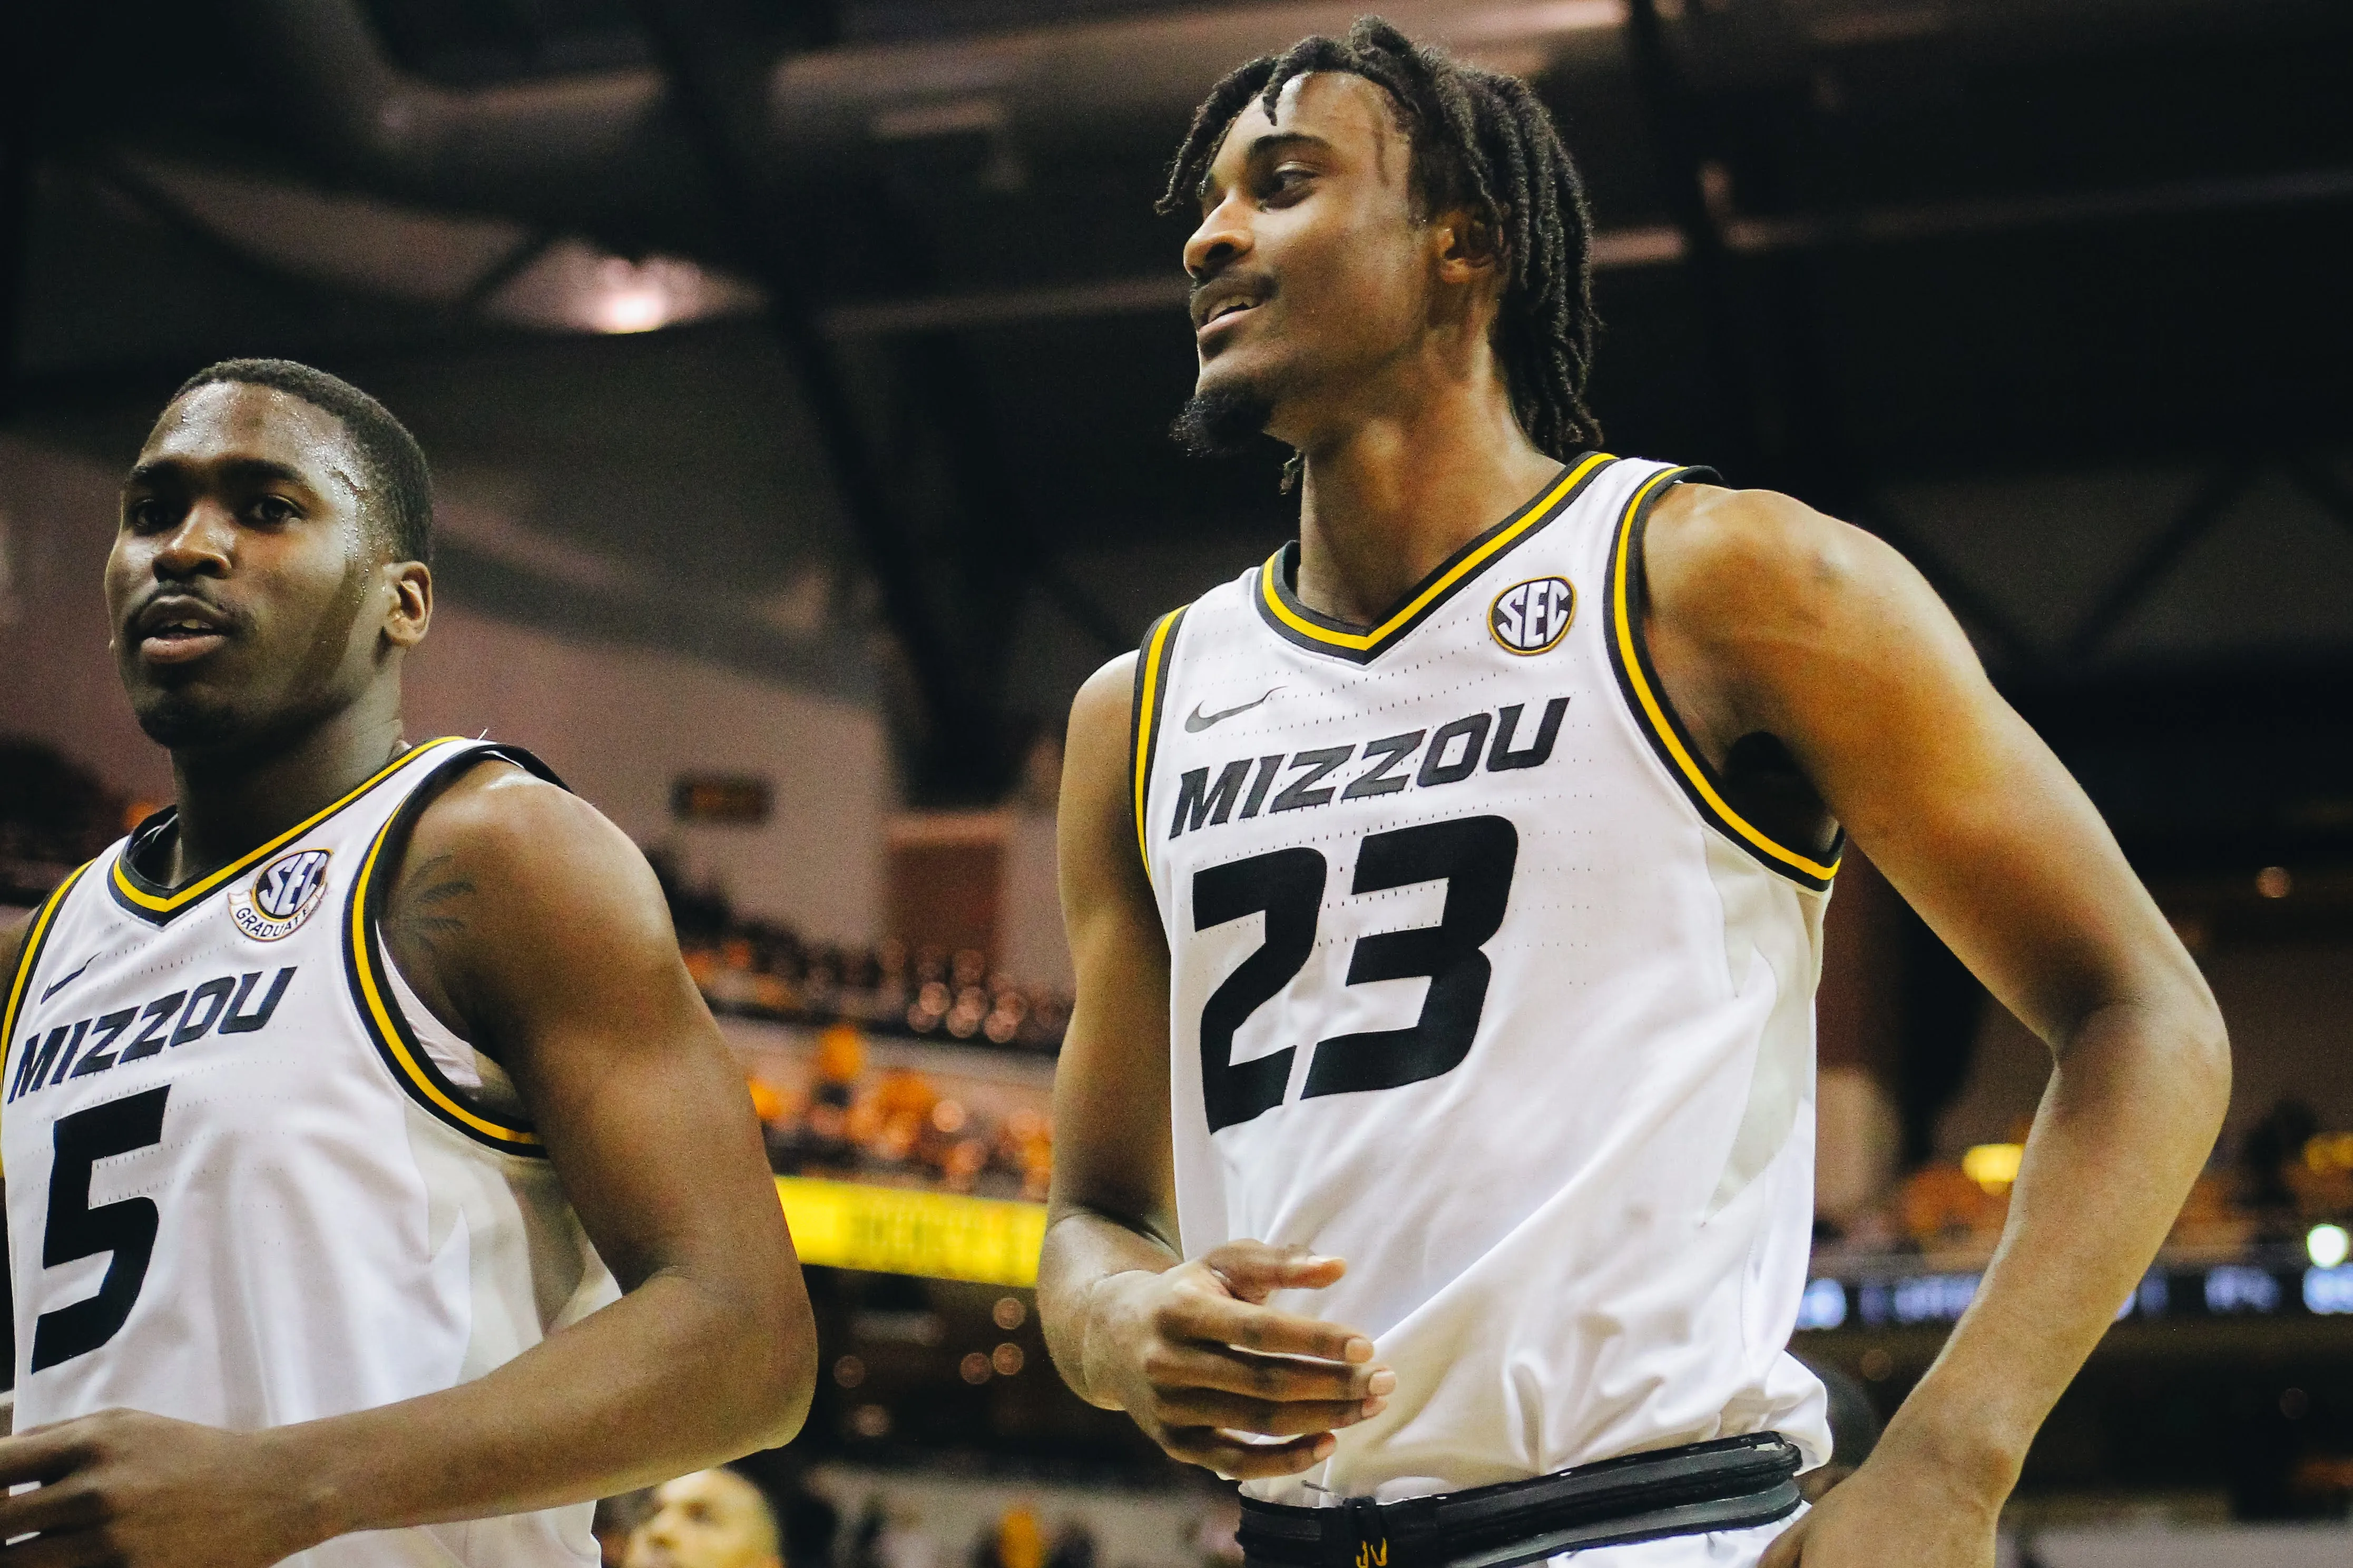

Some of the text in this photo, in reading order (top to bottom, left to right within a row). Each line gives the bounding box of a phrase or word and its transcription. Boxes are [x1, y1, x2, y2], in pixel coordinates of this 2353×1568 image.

[1497, 580, 1570, 647] SEC
[1169, 697, 1571, 840] MIZZOU
[258, 851, 328, 915] SEC
[8, 967, 298, 1104] MIZZOU
[1192, 815, 1518, 1135] 23
[32, 1084, 171, 1375] 5
